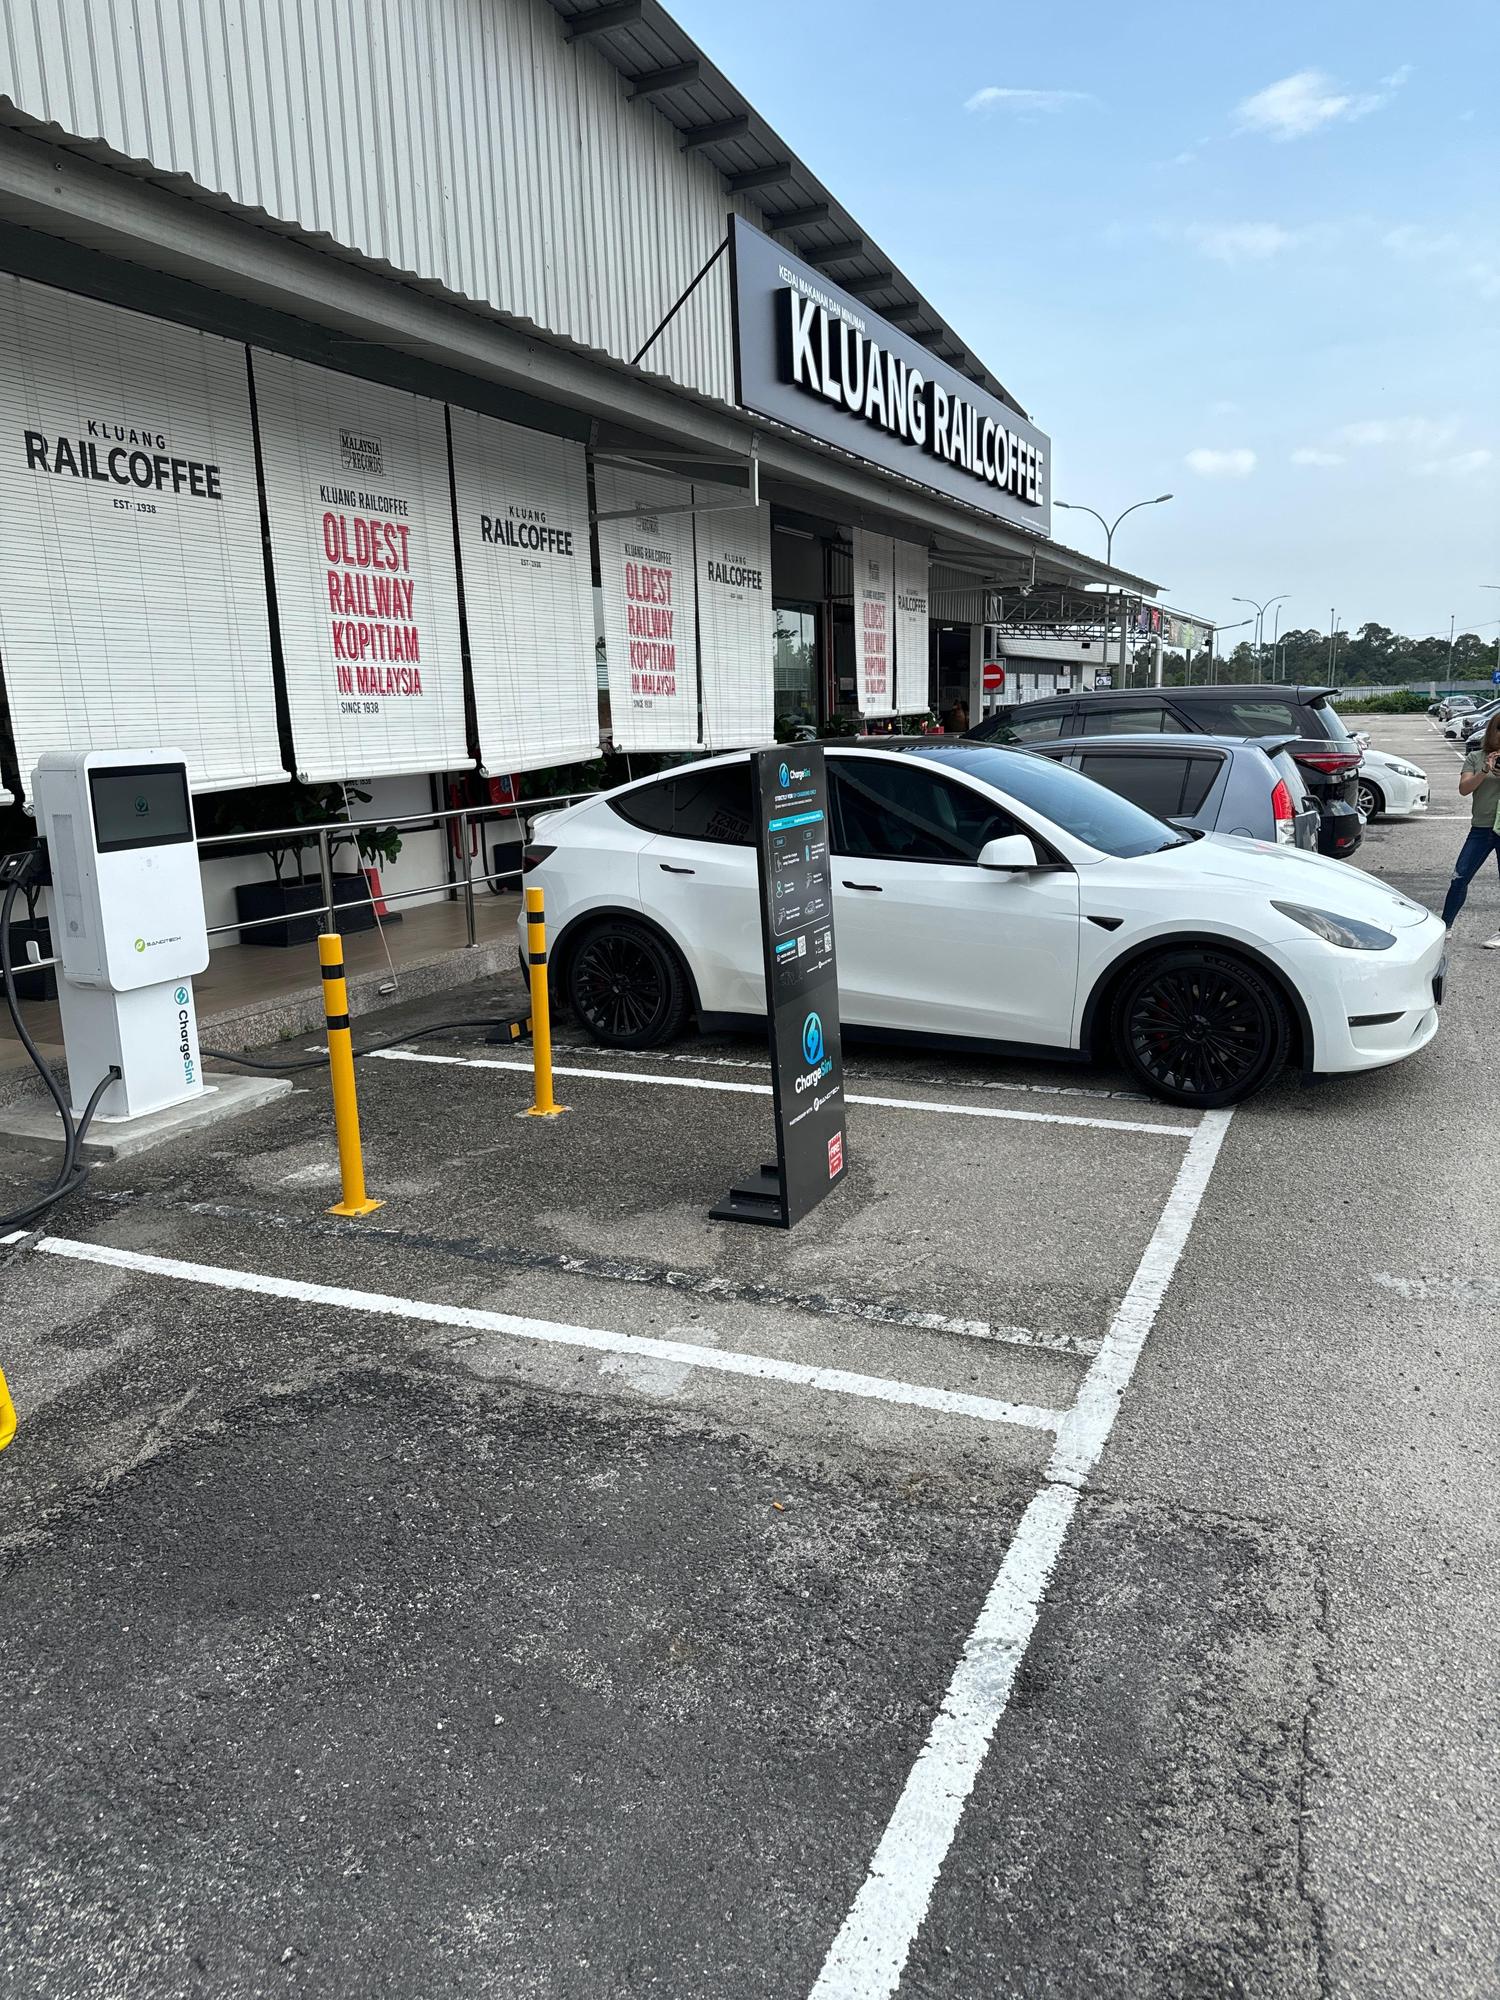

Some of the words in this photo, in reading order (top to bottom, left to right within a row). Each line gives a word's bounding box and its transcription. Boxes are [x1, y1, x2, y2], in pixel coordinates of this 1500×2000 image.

[779, 264, 799, 288] KEDAI
[800, 277, 828, 309] MAKANAN
[828, 298, 841, 316] DAN
[841, 306, 866, 334] MINUMAN
[788, 286, 926, 446] KLUANG
[933, 380, 1044, 506] RAILCOFFEE
[87, 420, 166, 449] KLUANG
[341, 435, 381, 455] MALAYSIA
[23, 430, 223, 500] RAILCOFFEE
[351, 451, 382, 474] RECORDS
[136, 503, 157, 514] 1938
[319, 484, 357, 508] KLUANG
[358, 493, 409, 517] RAILCOFFEE
[509, 505, 546, 523] KLUANG
[322, 511, 410, 573] OLDEST
[480, 514, 573, 556] RAILCOFFEE
[625, 561, 673, 605] OLDEST
[707, 560, 762, 591] RAILCOFFEE
[327, 569, 415, 621] RAILWAY
[898, 594, 927, 614] RAILCOFFEE
[627, 604, 674, 640] RAILWAY
[331, 620, 421, 664] KOPITIAM
[629, 640, 676, 673] KOPITIAM
[336, 665, 352, 695] IN
[356, 667, 423, 697] MALAYSIA
[631, 673, 640, 694] IN
[641, 674, 677, 697] MALAYSIA
[340, 701, 361, 714] SINCE
[362, 701, 380, 714] 1938
[178, 1010, 196, 1085] ChargeSini
[795, 1055, 832, 1094] ChargeSini
